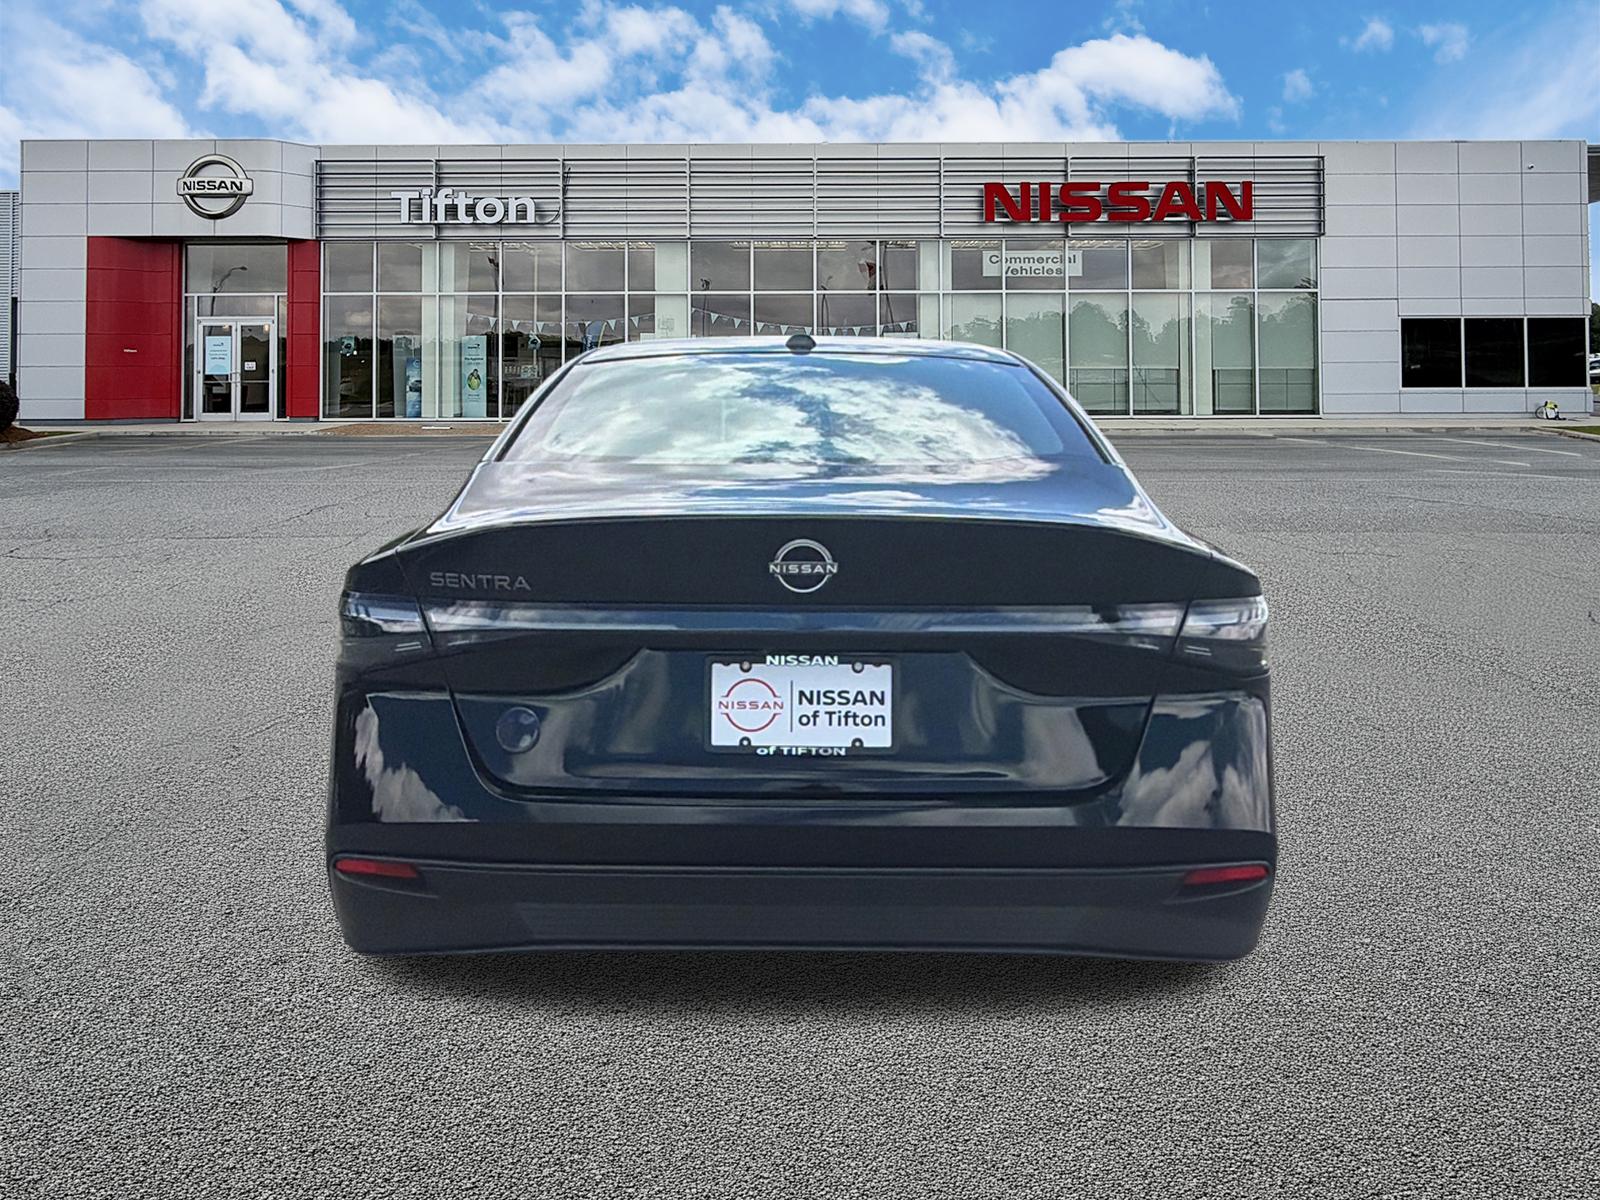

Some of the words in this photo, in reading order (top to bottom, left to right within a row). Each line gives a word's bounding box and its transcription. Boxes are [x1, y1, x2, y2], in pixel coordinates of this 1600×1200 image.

[183, 180, 243, 191] NISSAN
[391, 188, 536, 224] Tifton
[984, 181, 1254, 222] NISSAN
[769, 563, 838, 574] NISSAN
[430, 572, 532, 591] SENTRA
[766, 655, 839, 666] NISSAN
[798, 690, 885, 706] NISSAN
[718, 700, 784, 710] NISSAN
[798, 711, 820, 727] of
[824, 711, 886, 727] Tifton
[756, 746, 778, 756] of
[780, 747, 846, 756] TIFTON
